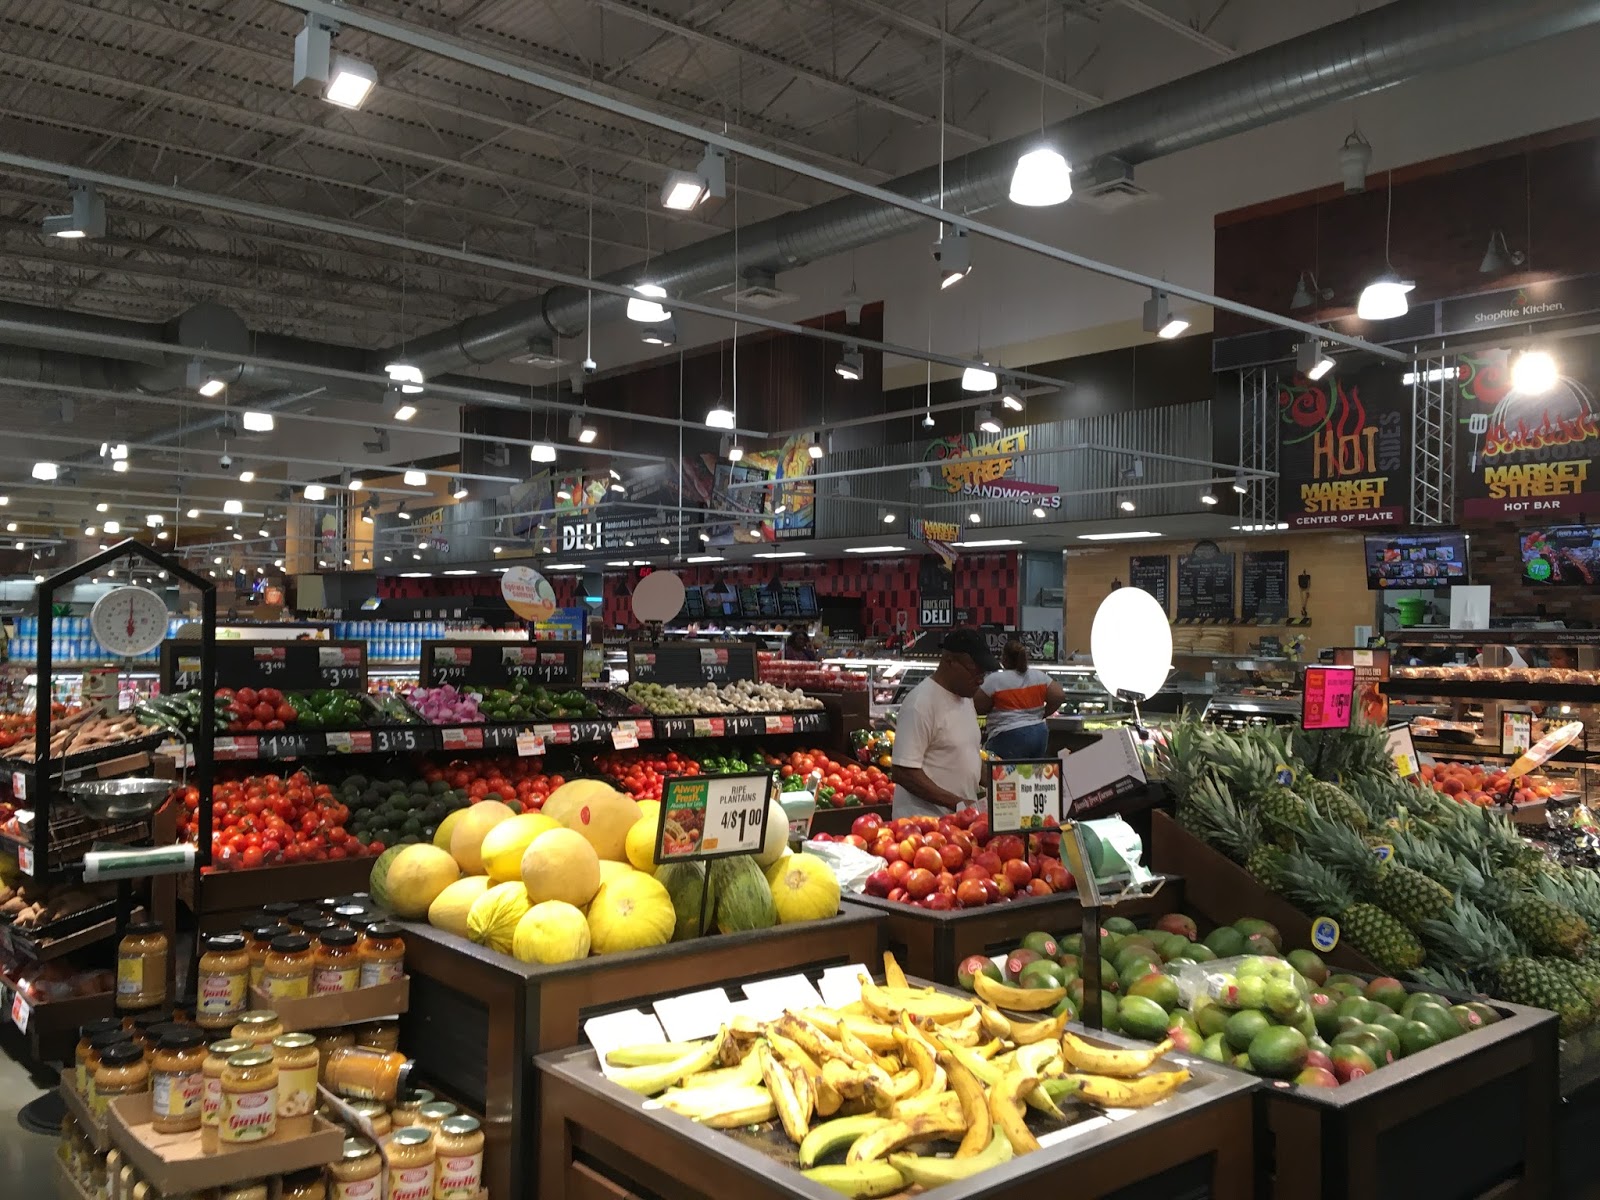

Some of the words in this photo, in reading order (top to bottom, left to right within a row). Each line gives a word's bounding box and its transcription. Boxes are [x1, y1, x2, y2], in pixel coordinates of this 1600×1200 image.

[1475, 307, 1520, 323] ShopRite
[1522, 302, 1563, 316] Kitchen
[1380, 411, 1400, 471] SIDES
[1313, 427, 1379, 479] HOT
[1484, 459, 1592, 485] MARKET
[1301, 477, 1389, 500] MARKET
[1488, 479, 1583, 499] STREET
[963, 484, 1061, 509] SANDWICHES
[1304, 492, 1381, 513] STREET
[1504, 502, 1530, 511] HOT
[1534, 500, 1560, 510] BAR
[1296, 515, 1338, 525] CENTER
[1340, 514, 1355, 522] OF
[1358, 511, 1394, 521] PLATE
[924, 521, 961, 532] MARKET
[562, 522, 603, 551] DELI
[926, 530, 959, 541] STREET
[922, 609, 951, 624] DELI
[672, 784, 705, 794] Always
[731, 785, 747, 795] RIPE
[1021, 783, 1033, 794] Ripe
[1034, 782, 1057, 793] Mangoes
[719, 792, 757, 805] PLANTAINS
[203, 989, 232, 999] Garlic
[315, 983, 344, 993] Garlic
[229, 1112, 273, 1130] Garlic
[439, 1177, 476, 1190] Garlic
[391, 1185, 431, 1200] Garlic
